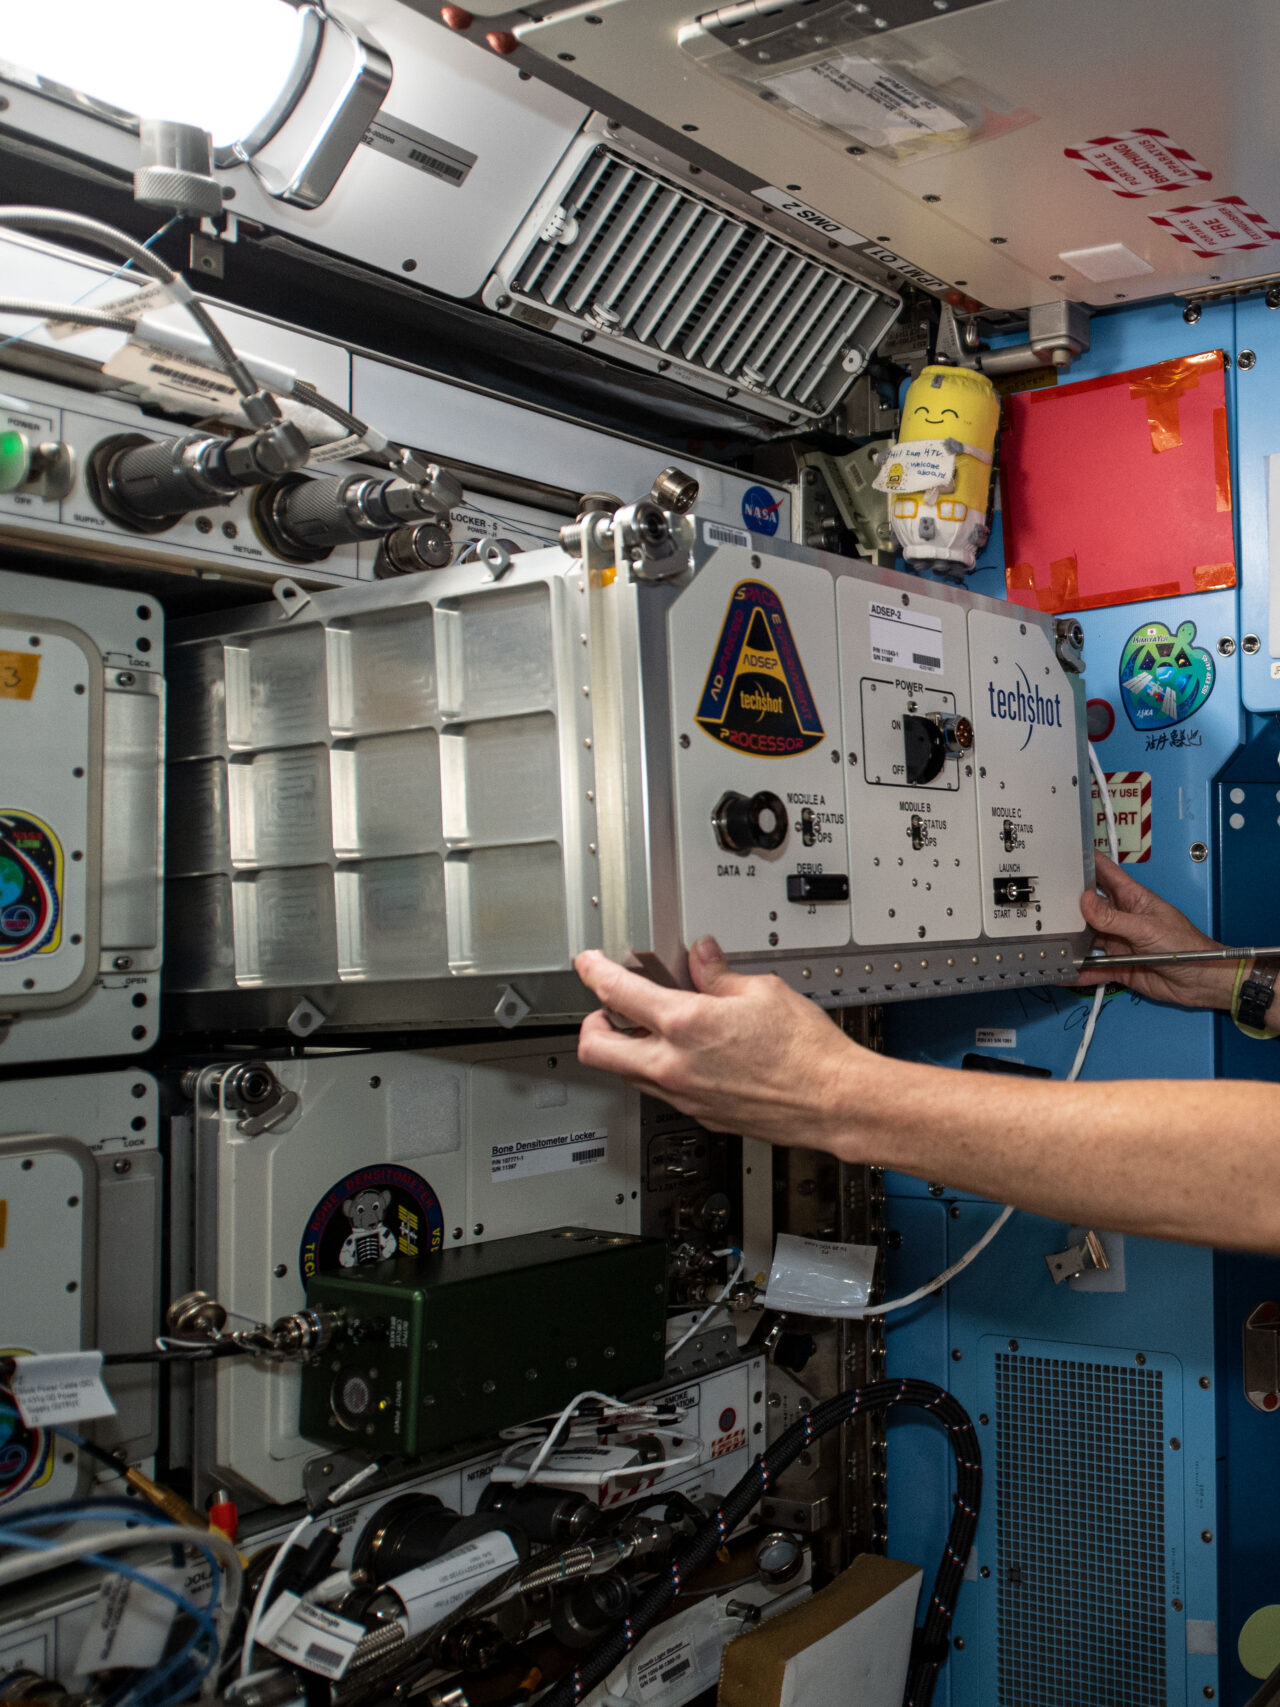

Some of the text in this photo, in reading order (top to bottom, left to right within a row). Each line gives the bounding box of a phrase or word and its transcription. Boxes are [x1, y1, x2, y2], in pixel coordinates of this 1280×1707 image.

[1113, 143, 1170, 184] BREATHING
[1138, 139, 1190, 177] APPARATUS
[1094, 152, 1142, 187] PORTABLE
[782, 201, 842, 233] DMS 2
[1202, 218, 1236, 239] FIRE
[74, 513, 106, 526] SUPPLY
[450, 512, 487, 528] LOCKER
[744, 503, 778, 524] NASA
[466, 525, 487, 536] POWER
[735, 586, 781, 610] SPACE
[871, 604, 902, 621] ADSEP-2
[742, 653, 779, 671] ADSEP
[895, 679, 925, 694] POWER
[740, 689, 784, 715] techshot
[988, 679, 1063, 728] techshot
[891, 719, 902, 731] ON
[719, 727, 805, 752] PROCESSOR
[892, 764, 906, 776] OFF
[786, 792, 826, 806] MODULE A
[1119, 787, 1139, 799] USE
[899, 801, 931, 813] MODULE B
[991, 806, 1022, 819] MODULE C
[816, 813, 845, 825] STATUS
[923, 819, 947, 830] STATUS
[1013, 823, 1034, 834] STATUS
[817, 832, 833, 844] OPS
[924, 836, 937, 847] OPS
[717, 864, 756, 877] DATA J2
[796, 863, 823, 875] DEBUG
[998, 862, 1021, 873] LAUNCH
[993, 909, 1028, 919] START END
[125, 977, 148, 985] OPEN
[492, 1130, 597, 1156] Bone Densitometer Locker
[311, 1168, 435, 1232] BONE DENSITOMETER
[664, 1390, 689, 1406] SMOKE
